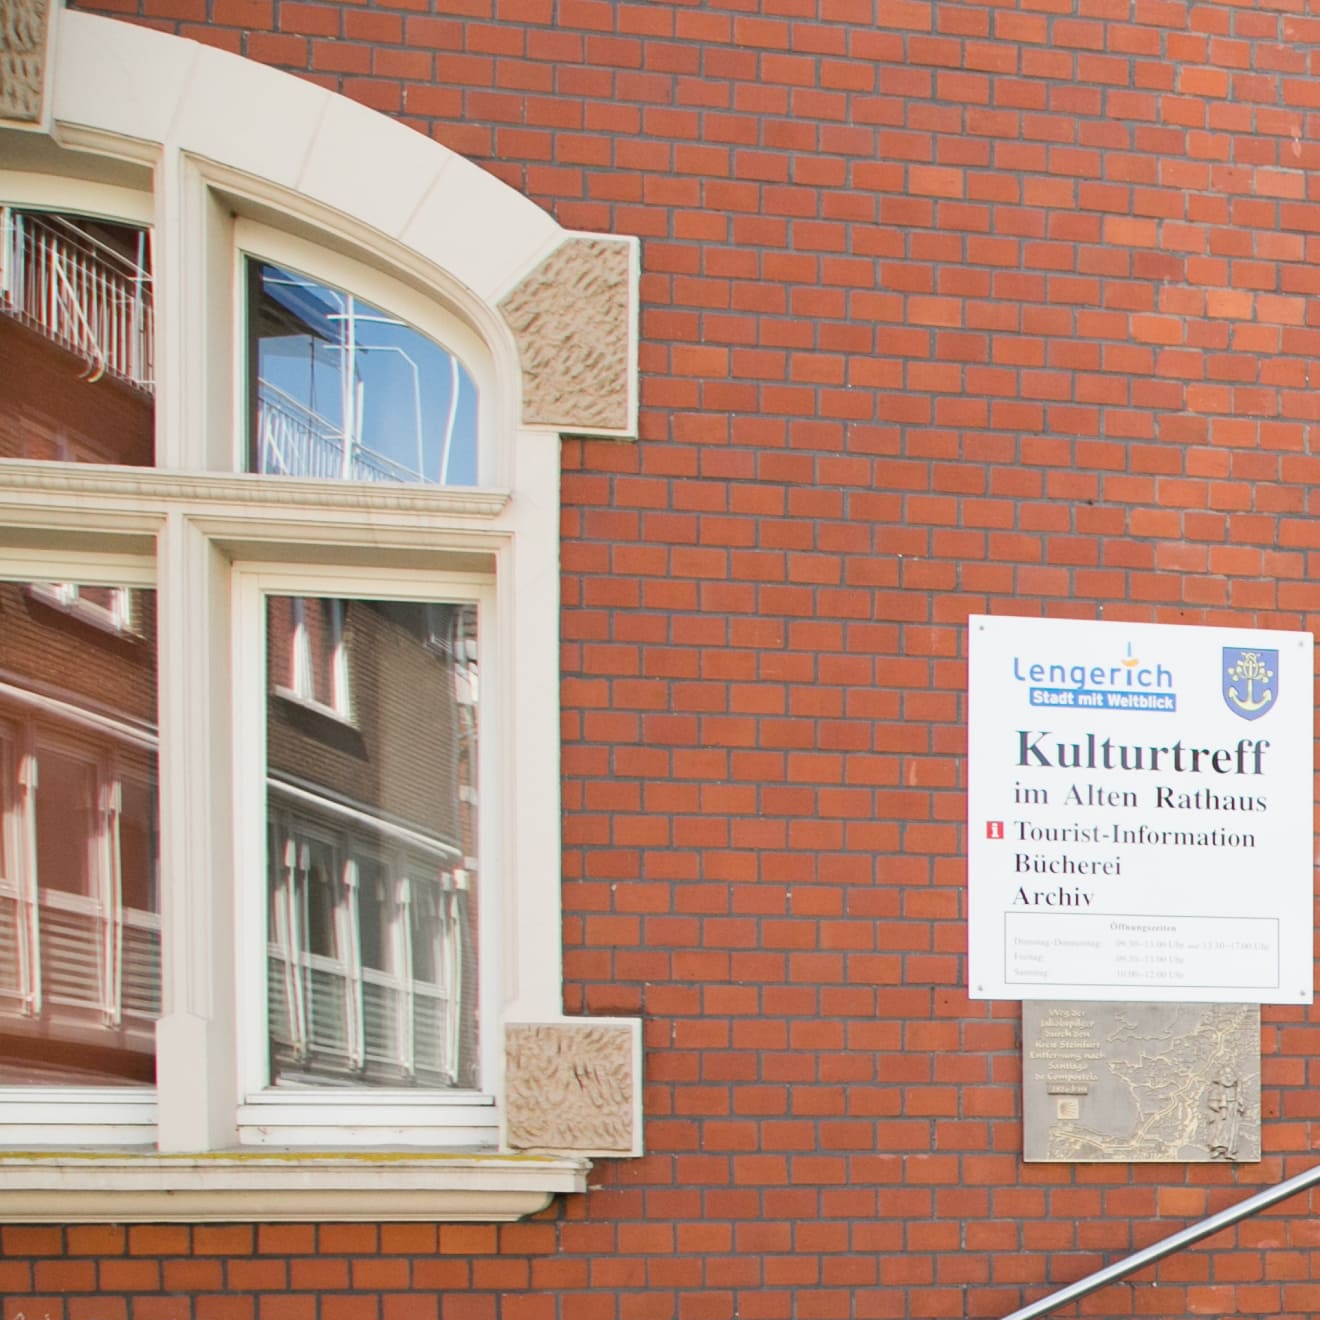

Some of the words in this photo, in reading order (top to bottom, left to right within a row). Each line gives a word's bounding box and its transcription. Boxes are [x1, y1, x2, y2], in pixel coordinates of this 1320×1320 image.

[1013, 656, 1173, 689] Lengerich
[1033, 690, 1074, 705] Stadt
[1078, 692, 1103, 706] mit
[1107, 694, 1174, 709] Weitblick
[1015, 730, 1271, 775] Kulturtreff
[1014, 781, 1049, 804] im
[1064, 783, 1138, 807] Alten
[1155, 786, 1267, 812] Rathaus
[1014, 821, 1255, 848] Tourist-Information
[1014, 853, 1121, 876] Bücherei
[1012, 886, 1095, 907] Archiv
